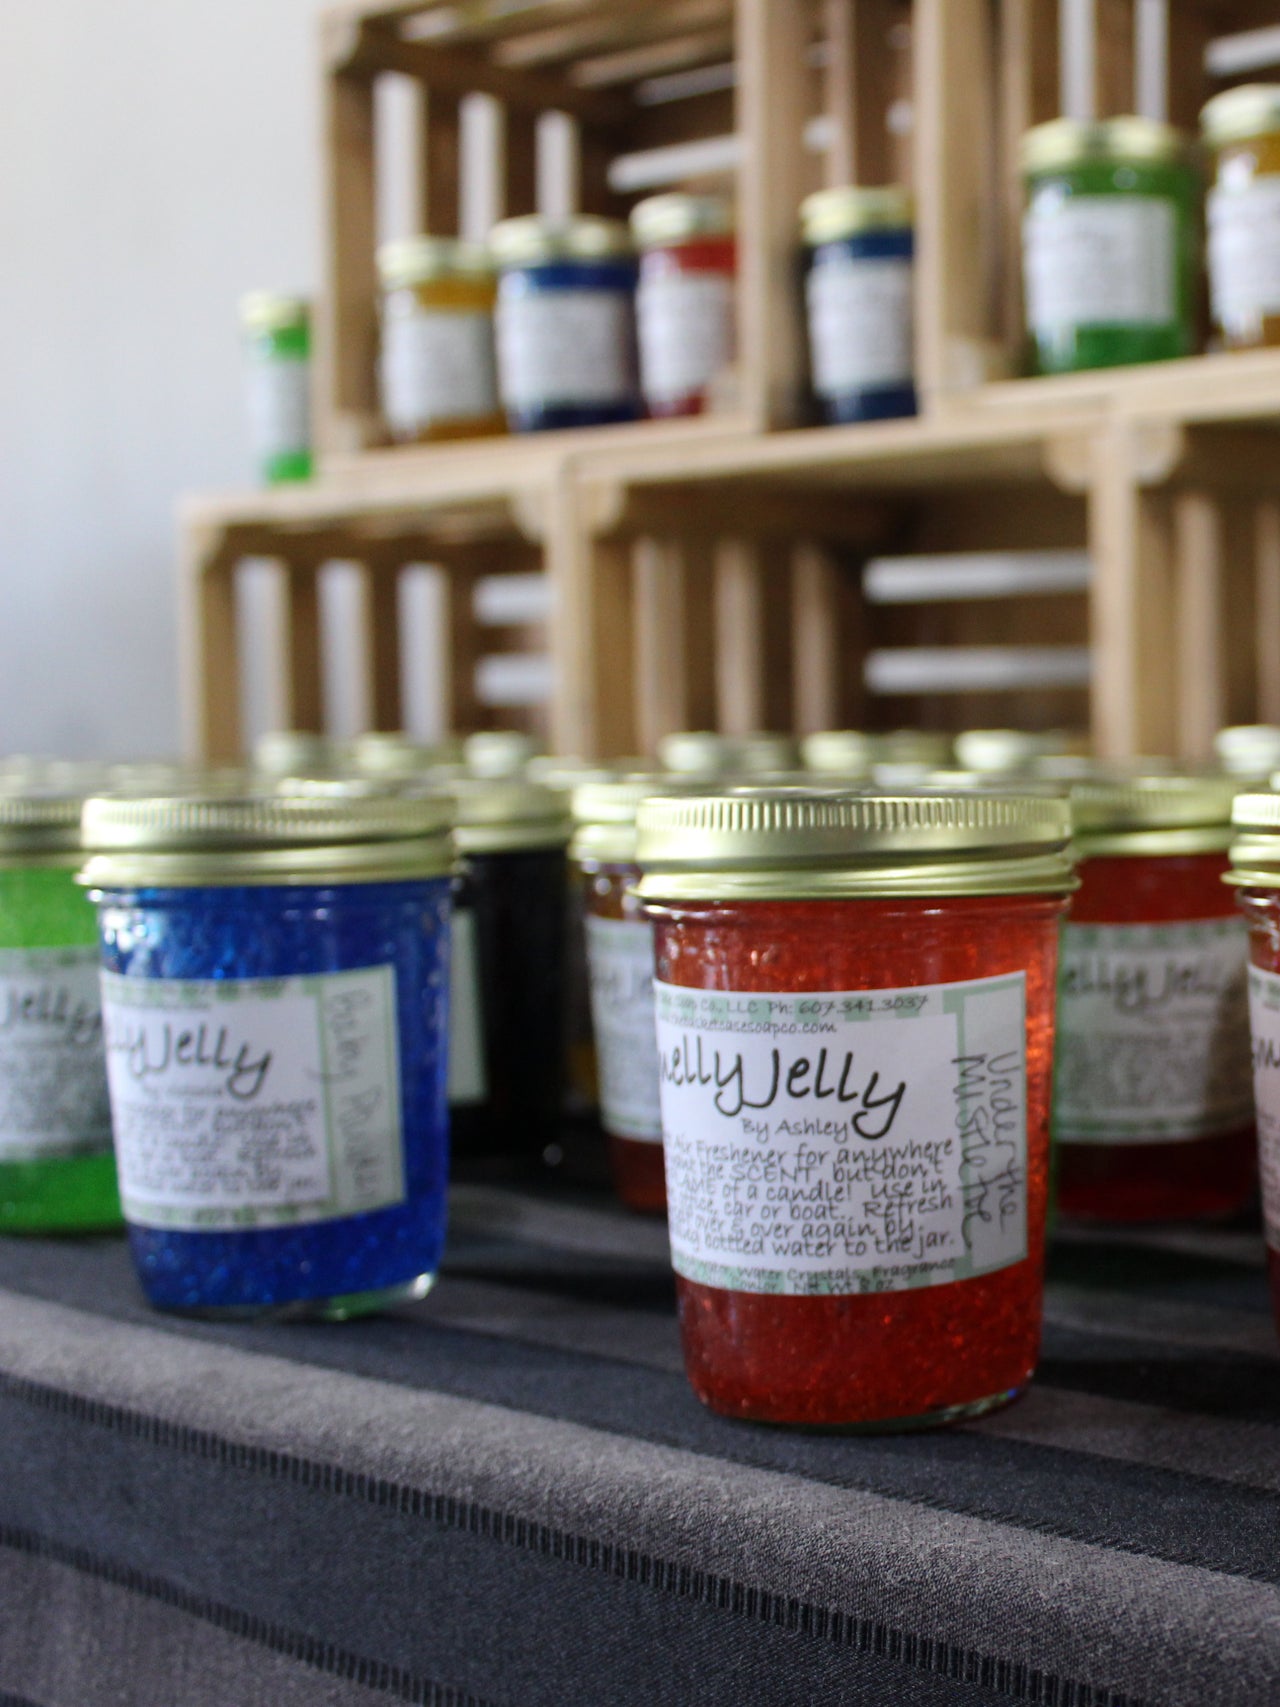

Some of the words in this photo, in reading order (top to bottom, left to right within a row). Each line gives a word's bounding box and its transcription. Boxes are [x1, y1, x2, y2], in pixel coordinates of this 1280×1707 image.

[727, 1001, 758, 1013] LLC
[768, 1000, 792, 1013] Ph:
[144, 1022, 273, 1099] Jelly
[742, 1047, 907, 1140] Jelly
[741, 1117, 769, 1144] By
[777, 1117, 851, 1144] Ashley
[696, 1140, 786, 1165] Freshener
[795, 1143, 829, 1167] for
[837, 1138, 954, 1168] anywhere
[833, 1162, 873, 1182] but
[722, 1180, 740, 1201] of
[747, 1183, 759, 1199] a
[871, 1181, 913, 1198] Use
[922, 1178, 947, 1192] in
[761, 1206, 782, 1219] or
[863, 1195, 952, 1217] Refresh
[751, 1223, 793, 1238] over
[802, 1218, 875, 1243] again
[772, 1239, 835, 1257] water
[845, 1240, 866, 1255] to
[875, 1237, 911, 1253] the
